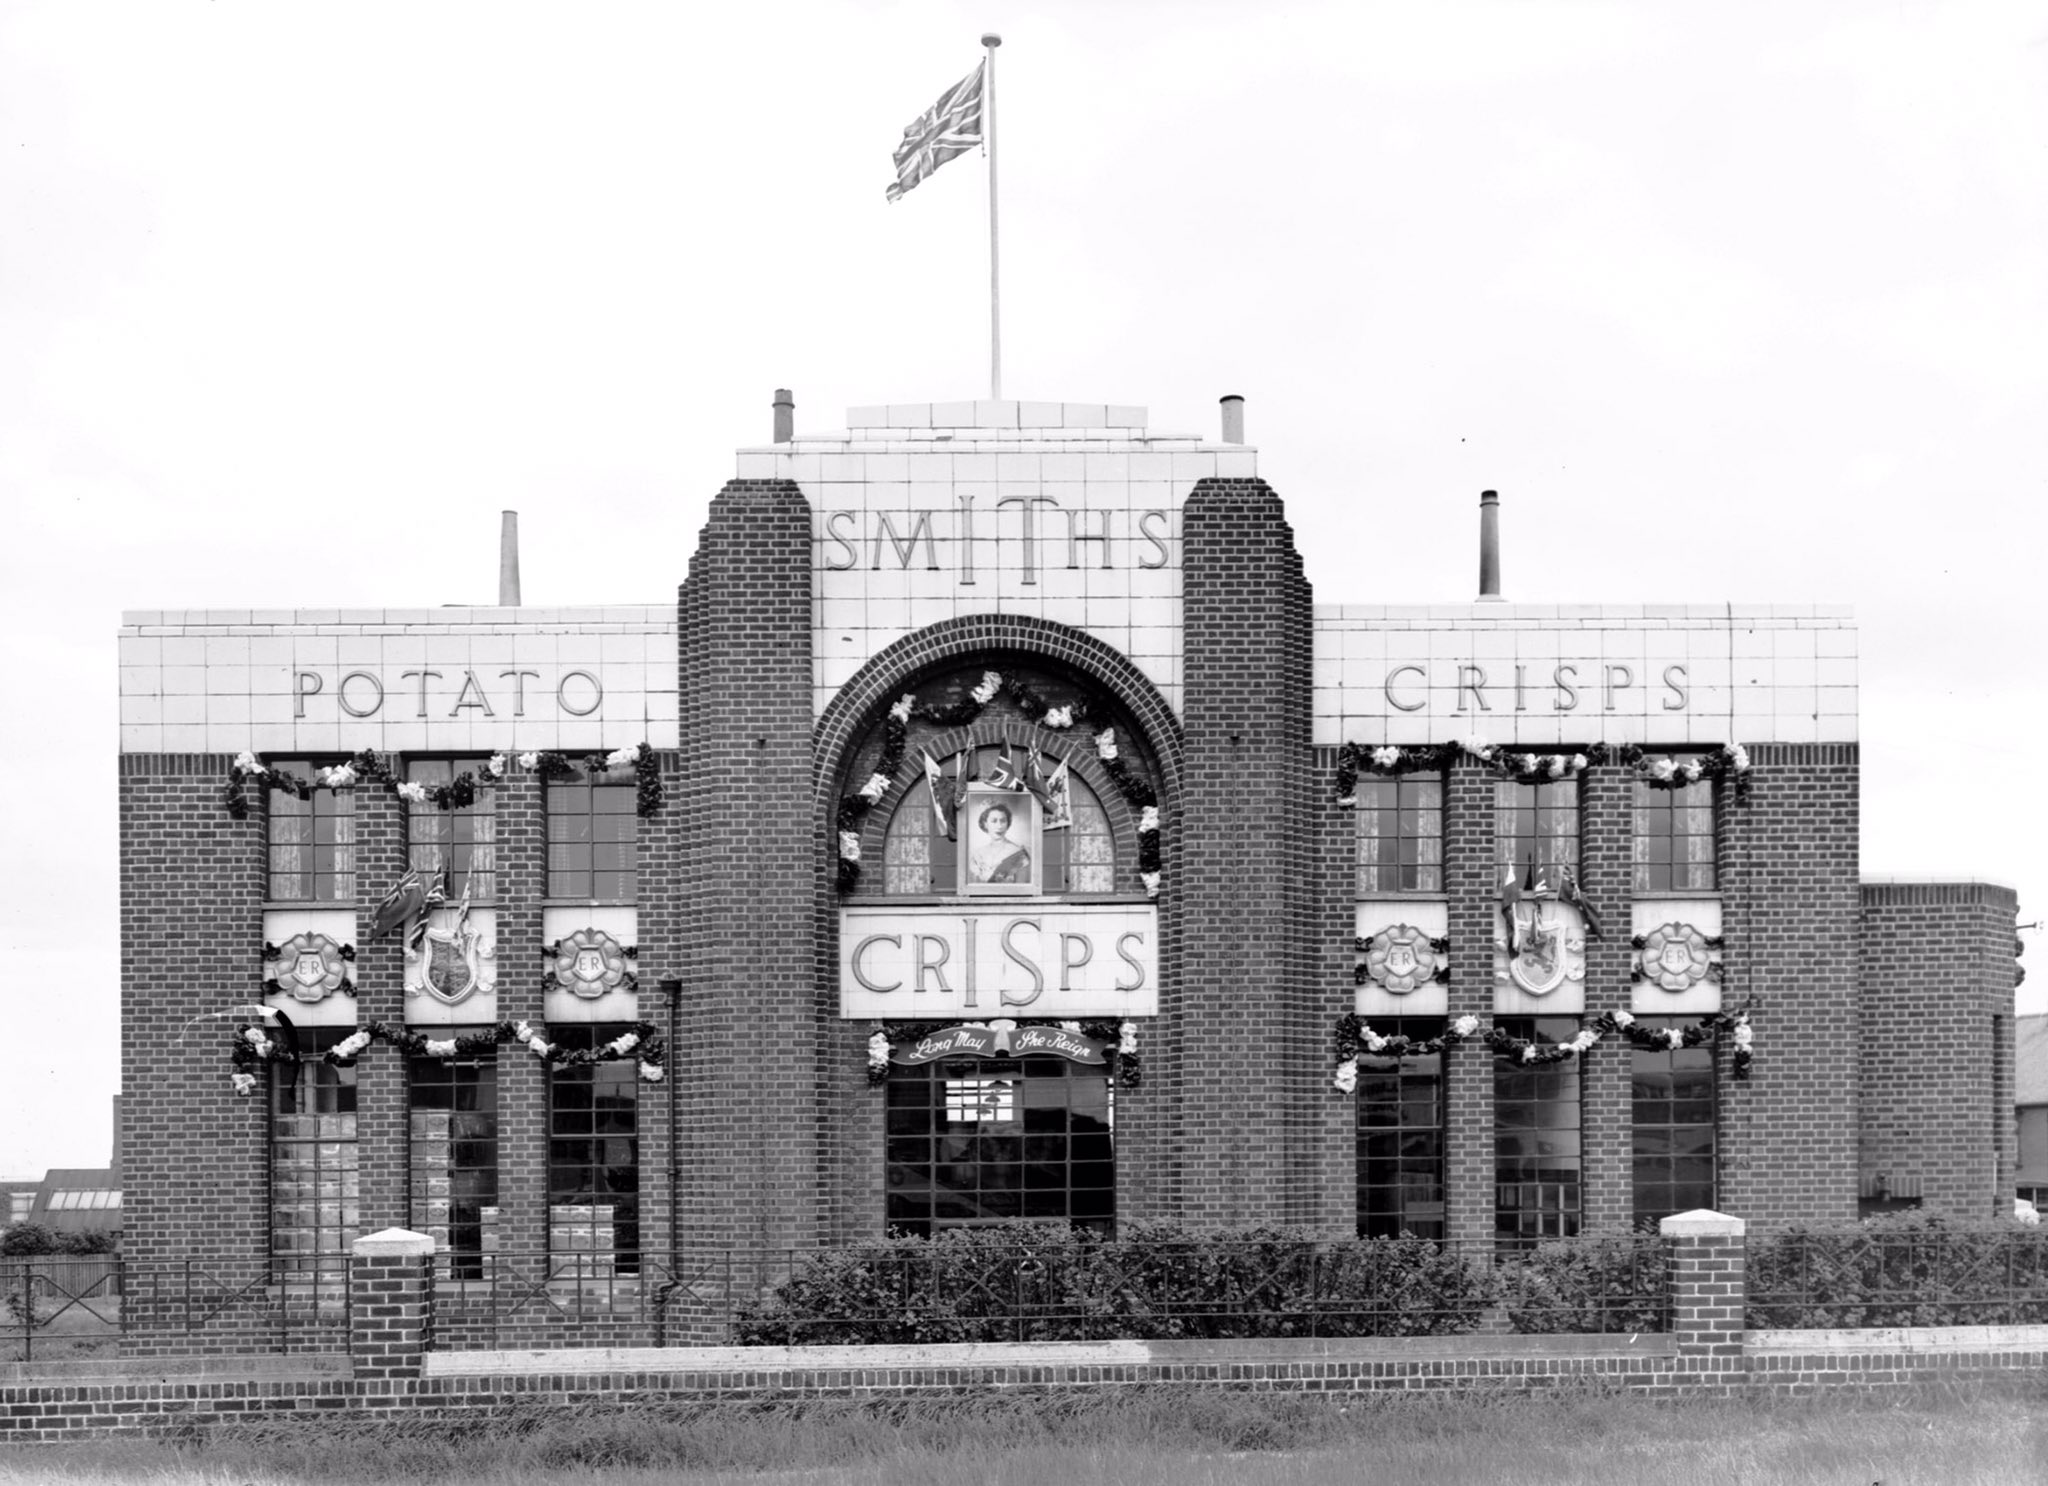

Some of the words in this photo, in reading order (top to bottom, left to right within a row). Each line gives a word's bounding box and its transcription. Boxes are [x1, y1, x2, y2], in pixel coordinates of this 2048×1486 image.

[825, 495, 1168, 585] SMITHS
[293, 669, 604, 718] POTATO
[1384, 664, 1690, 712] CRISPS
[298, 959, 320, 975] ER
[578, 955, 601, 971] ER
[851, 918, 1146, 1008] CRISPS
[1390, 950, 1411, 966] ER
[1664, 948, 1686, 964] ER
[909, 1037, 952, 1059] Long
[953, 1030, 987, 1050] May
[1015, 1031, 1045, 1050] She
[1046, 1031, 1092, 1058] Reign
